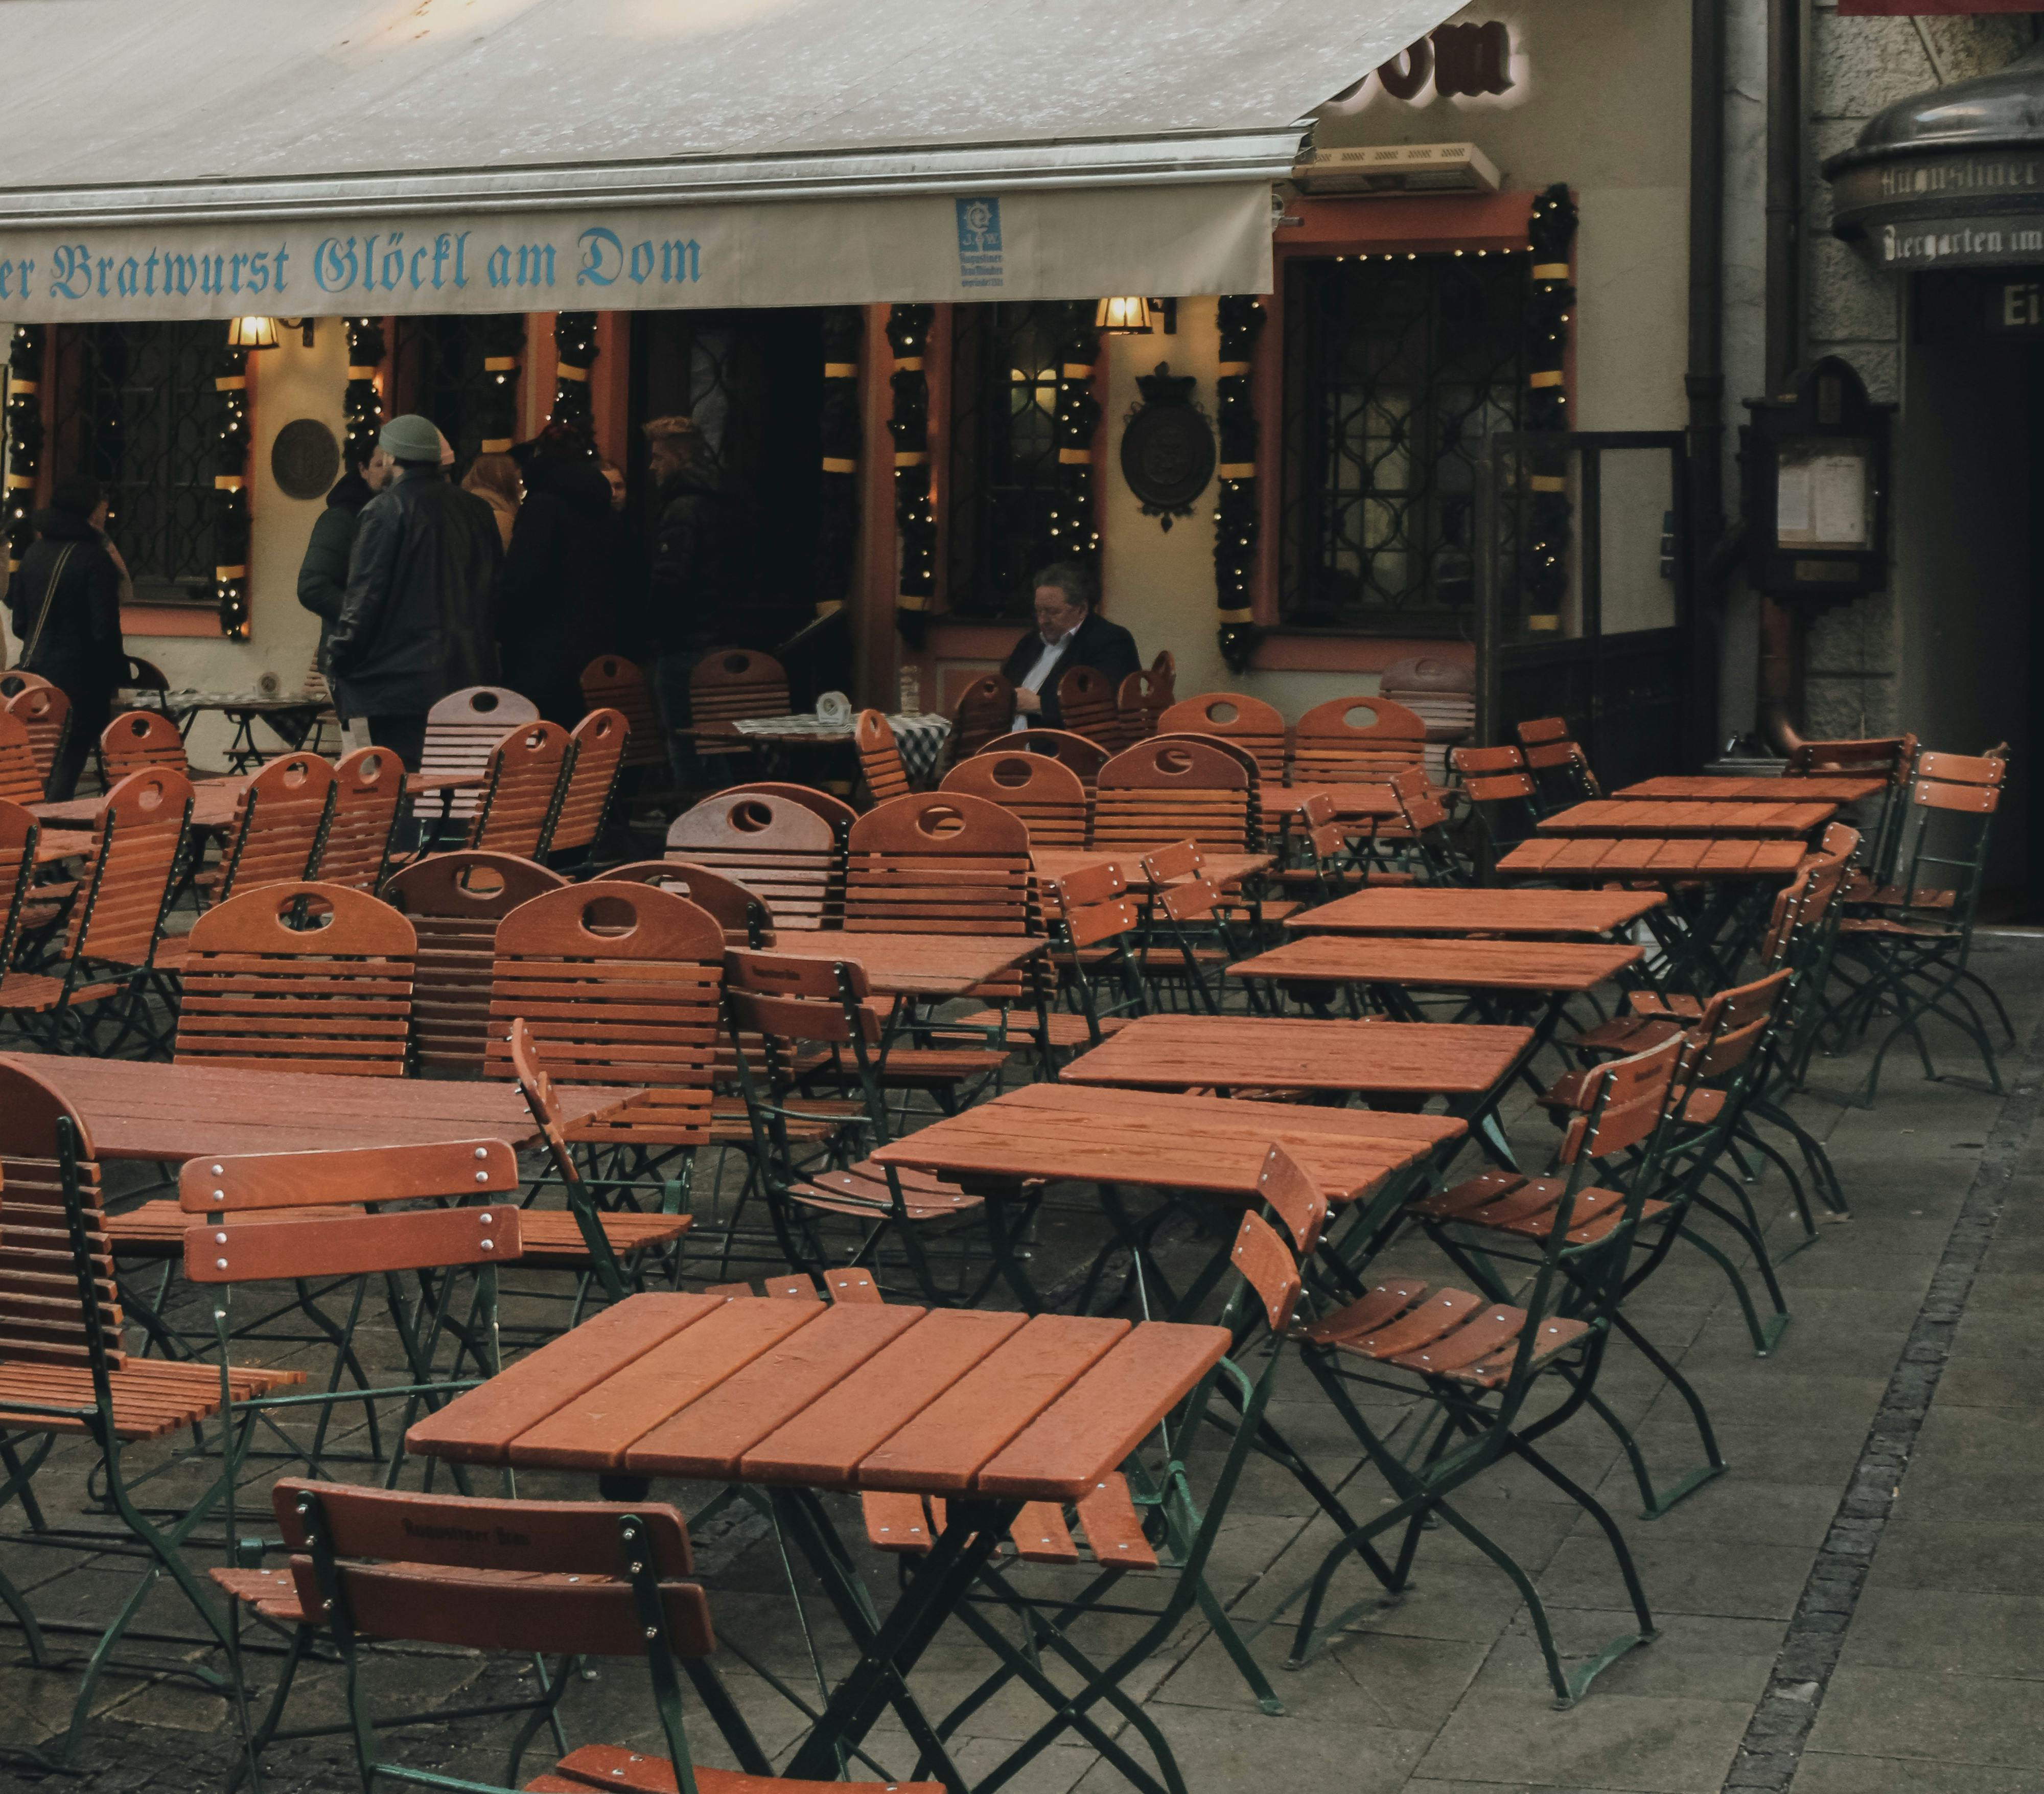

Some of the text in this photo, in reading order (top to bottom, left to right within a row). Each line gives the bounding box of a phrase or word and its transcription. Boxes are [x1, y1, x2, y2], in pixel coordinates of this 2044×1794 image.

[1328, 20, 1516, 102] om
[51, 241, 289, 300] Bratwurst
[314, 232, 471, 293] Glöckl
[487, 242, 556, 288] am
[576, 227, 702, 286] Dom
